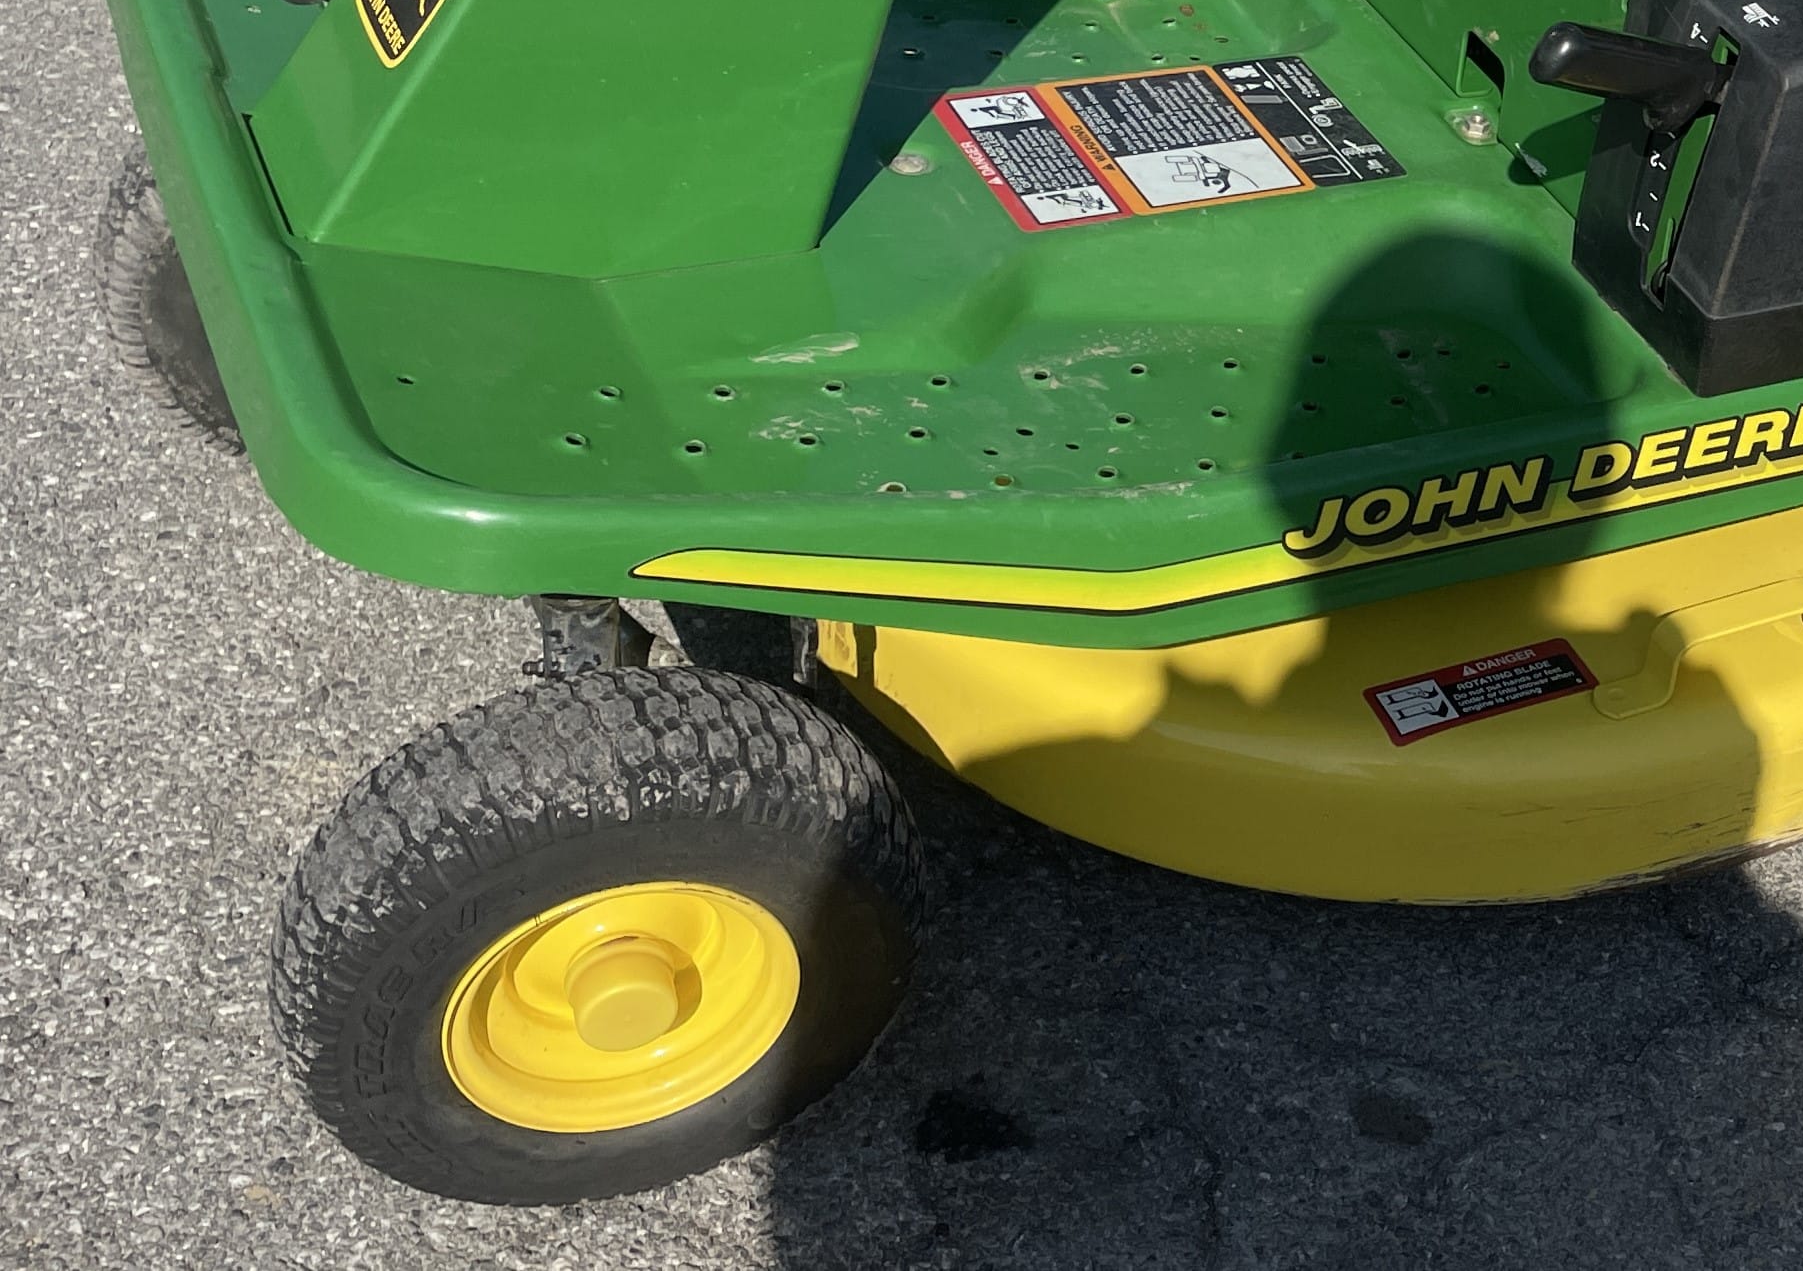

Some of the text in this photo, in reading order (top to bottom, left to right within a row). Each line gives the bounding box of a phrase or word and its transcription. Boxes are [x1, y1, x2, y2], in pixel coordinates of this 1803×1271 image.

[378, 7, 406, 56] DEERE
[960, 140, 995, 175] DANGER
[1070, 124, 1108, 161] WARNING
[1282, 455, 1554, 558] JOHN
[1456, 660, 1551, 690] ROTATING BLADE
[1475, 649, 1536, 671] DANGER
[1453, 692, 1468, 700] Do
[1468, 687, 1485, 695] not
[1485, 683, 1502, 692] put
[1502, 674, 1531, 686] hands
[1543, 666, 1561, 674] feet
